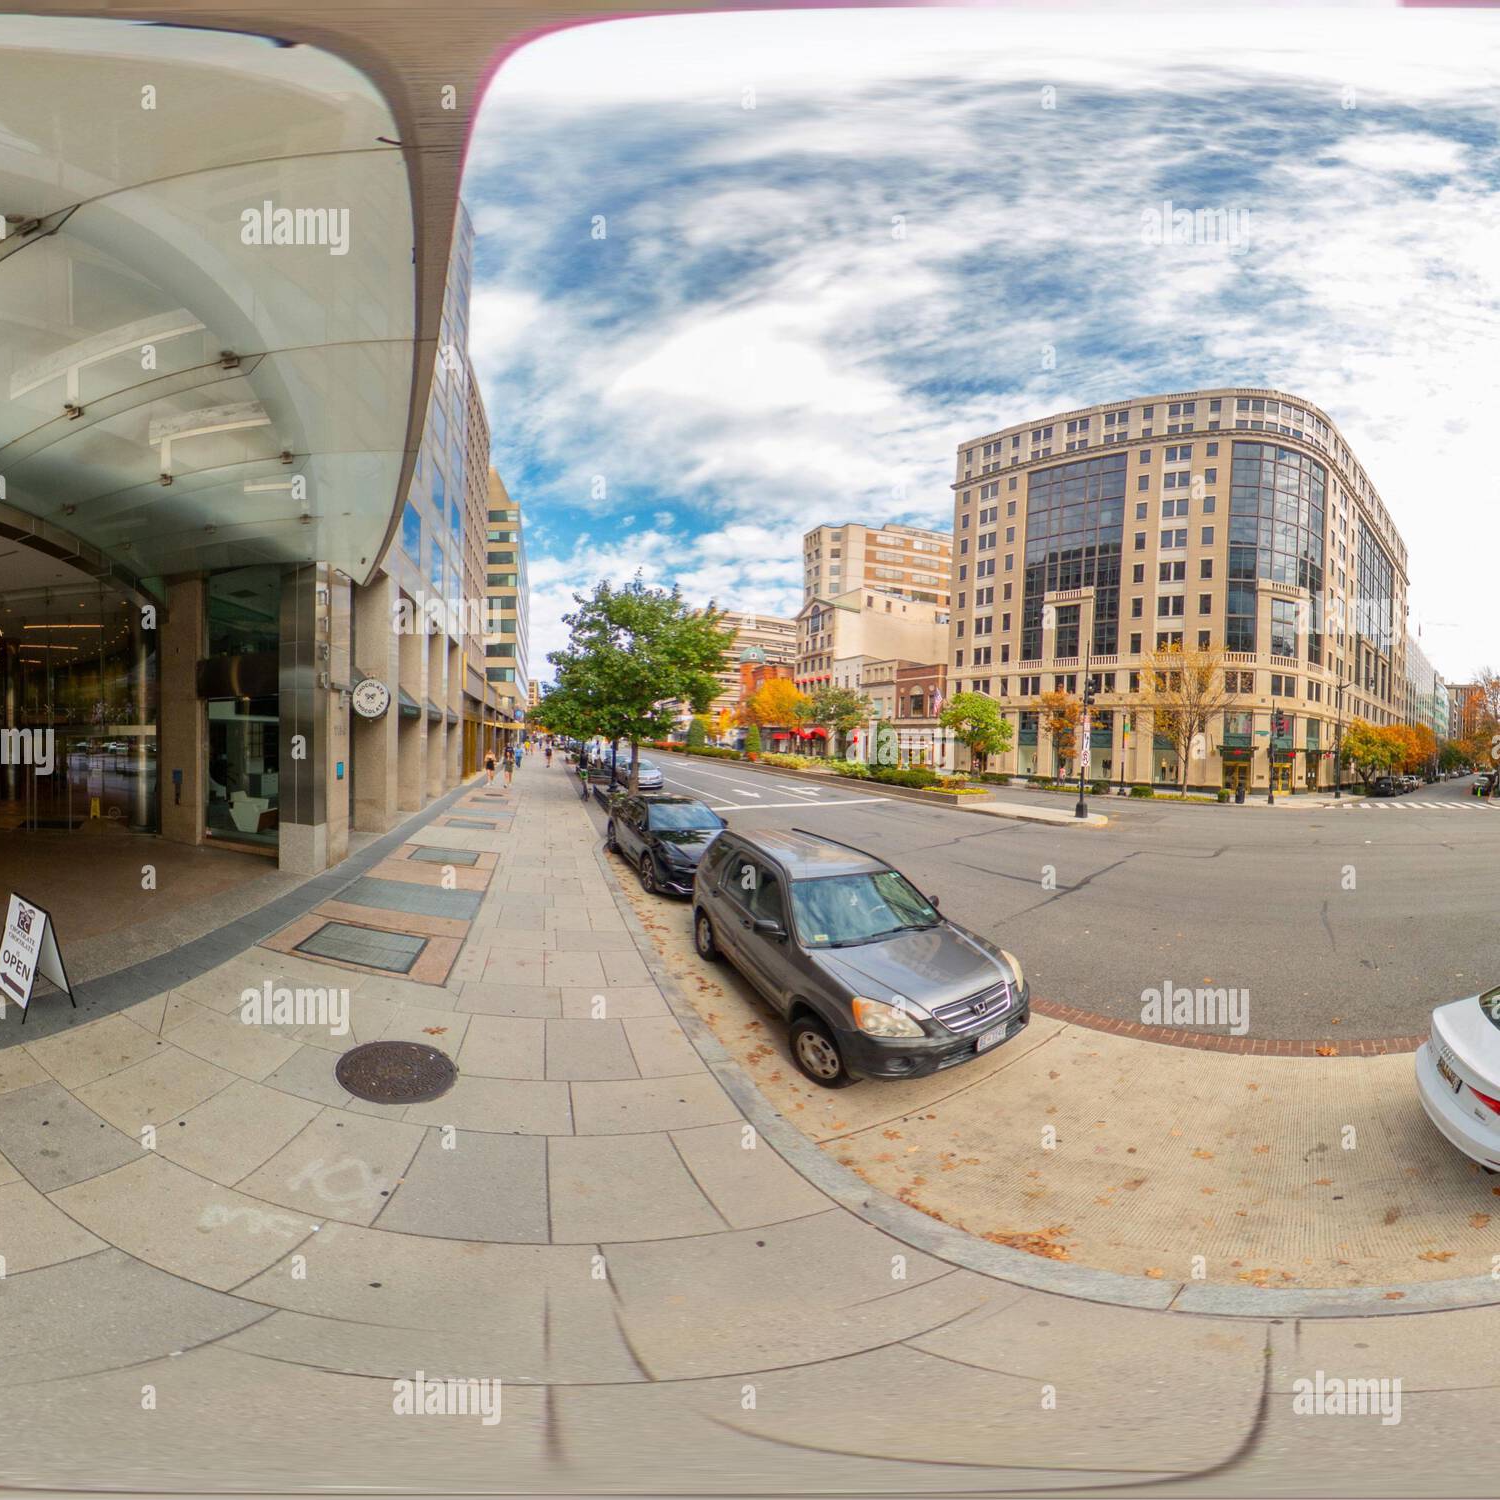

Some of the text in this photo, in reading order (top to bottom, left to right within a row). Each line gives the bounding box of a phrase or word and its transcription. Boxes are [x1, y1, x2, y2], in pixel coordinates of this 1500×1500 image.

[356, 682, 385, 697] CHOCOLATE
[356, 700, 385, 714] CHOCOLATE
[2, 948, 30, 981] OPEN
